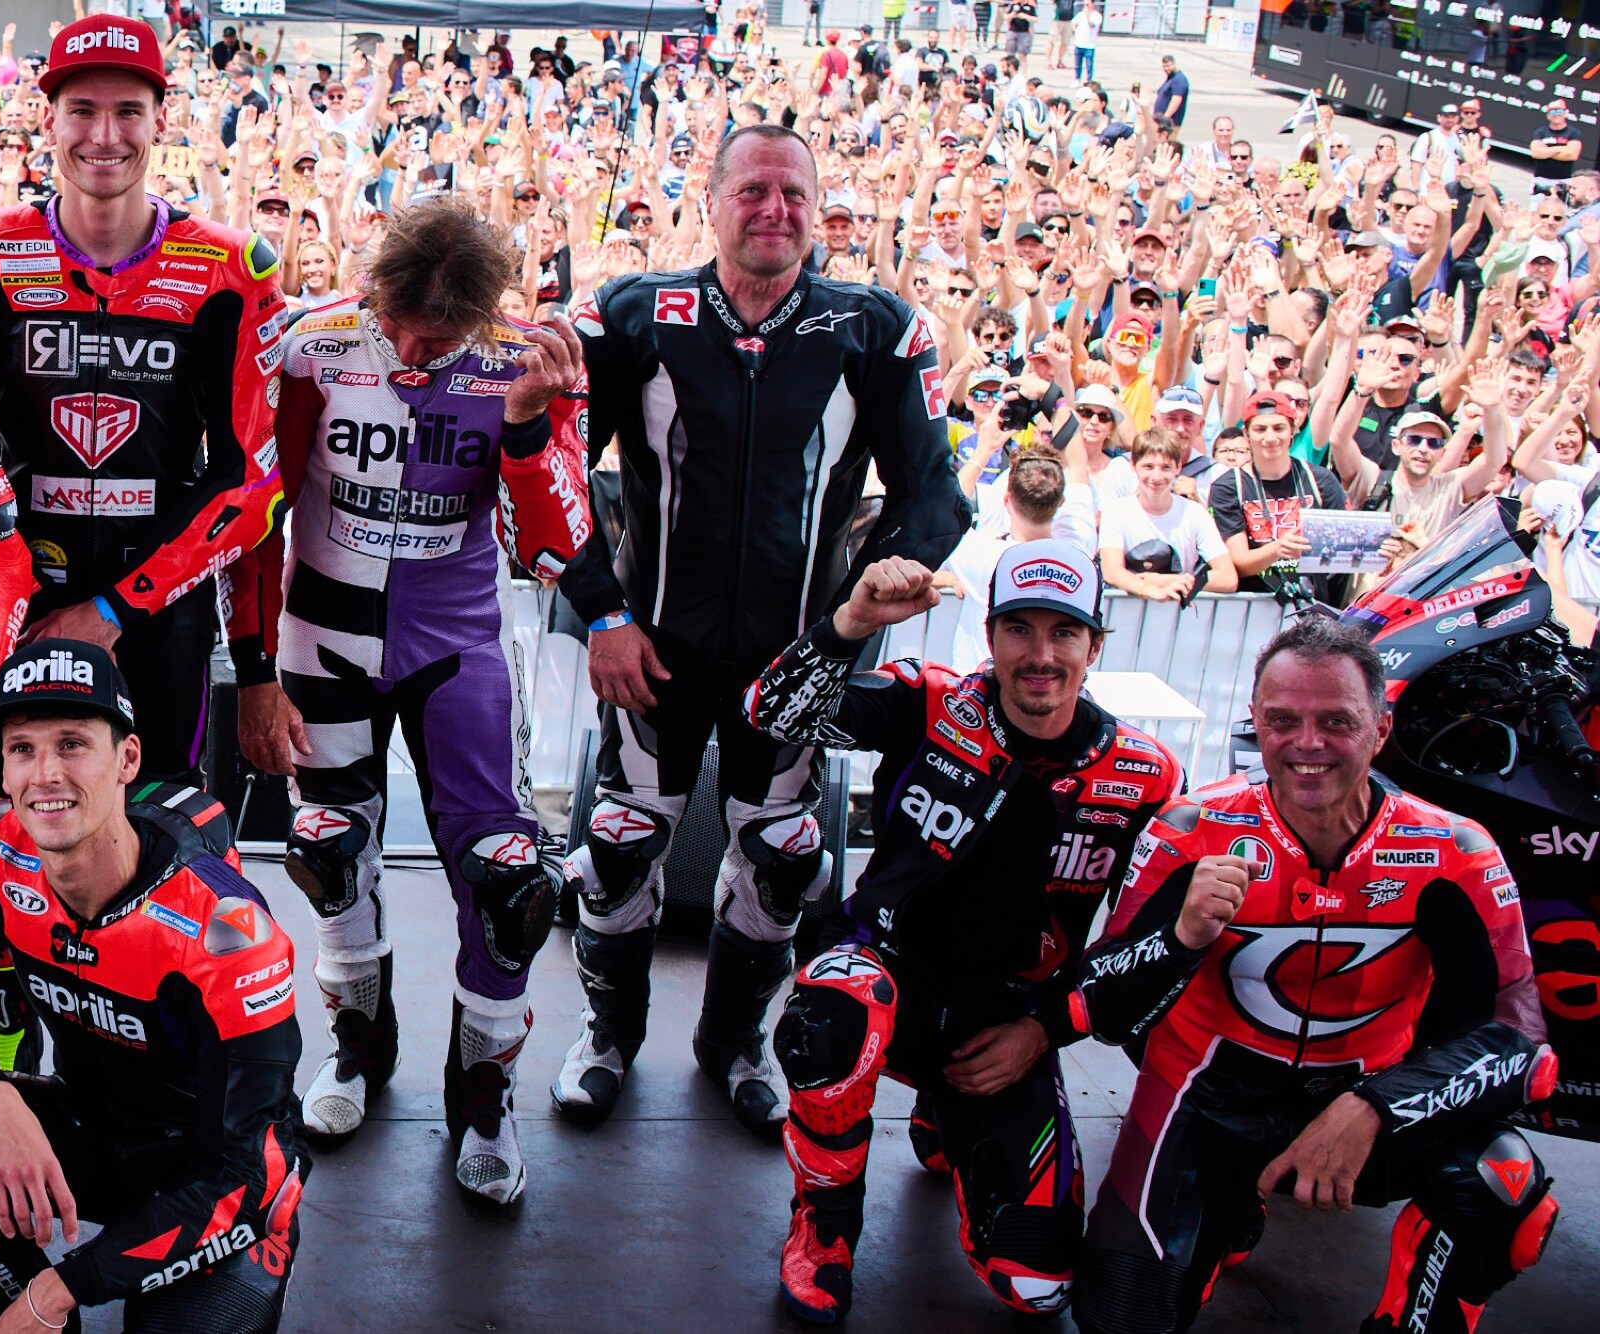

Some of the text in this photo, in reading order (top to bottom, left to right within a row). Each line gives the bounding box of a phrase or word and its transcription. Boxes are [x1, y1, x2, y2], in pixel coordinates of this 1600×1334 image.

[221, 0, 285, 16] aprilia
[65, 26, 140, 54] aprilia
[26, 242, 53, 252] EDIL
[175, 246, 225, 257] DUNLOP
[161, 280, 205, 293] panealba
[144, 296, 183, 310] Campiello
[658, 291, 696, 324] R
[299, 315, 354, 332] PIRELLI
[306, 341, 341, 353] Arai
[111, 369, 173, 382] Racing Project
[323, 368, 342, 376] KIT
[339, 374, 378, 385] GRAM
[455, 376, 473, 384] KIT
[72, 401, 117, 409] NUOVA
[327, 412, 492, 474] aprilia
[44, 486, 153, 511] ARCADE
[331, 476, 471, 517] OLD SCHOOL
[548, 450, 590, 551] aprilia
[422, 547, 447, 557] PLUS
[165, 545, 242, 606] aprilia
[1017, 564, 1080, 591] sterilgarda
[2, 650, 94, 694] aprilia
[23, 684, 94, 694] RACING
[987, 705, 1007, 749] aprilia
[925, 752, 962, 782] CAME
[1115, 761, 1149, 773] CASE
[1255, 786, 1306, 859] DAINESE
[1345, 795, 1400, 868] DAINESE
[1530, 825, 1600, 862] sky
[3, 847, 38, 868] MICHELIN
[1376, 851, 1436, 866] MAURER
[1360, 877, 1408, 895] Star
[6, 886, 47, 912] KYT
[1366, 890, 1405, 908] Line
[157, 909, 196, 934] MICHELIN
[29, 973, 147, 1042] aprilia
[141, 1223, 256, 1294] aprilia
[1408, 1229, 1454, 1334] DAINESE
